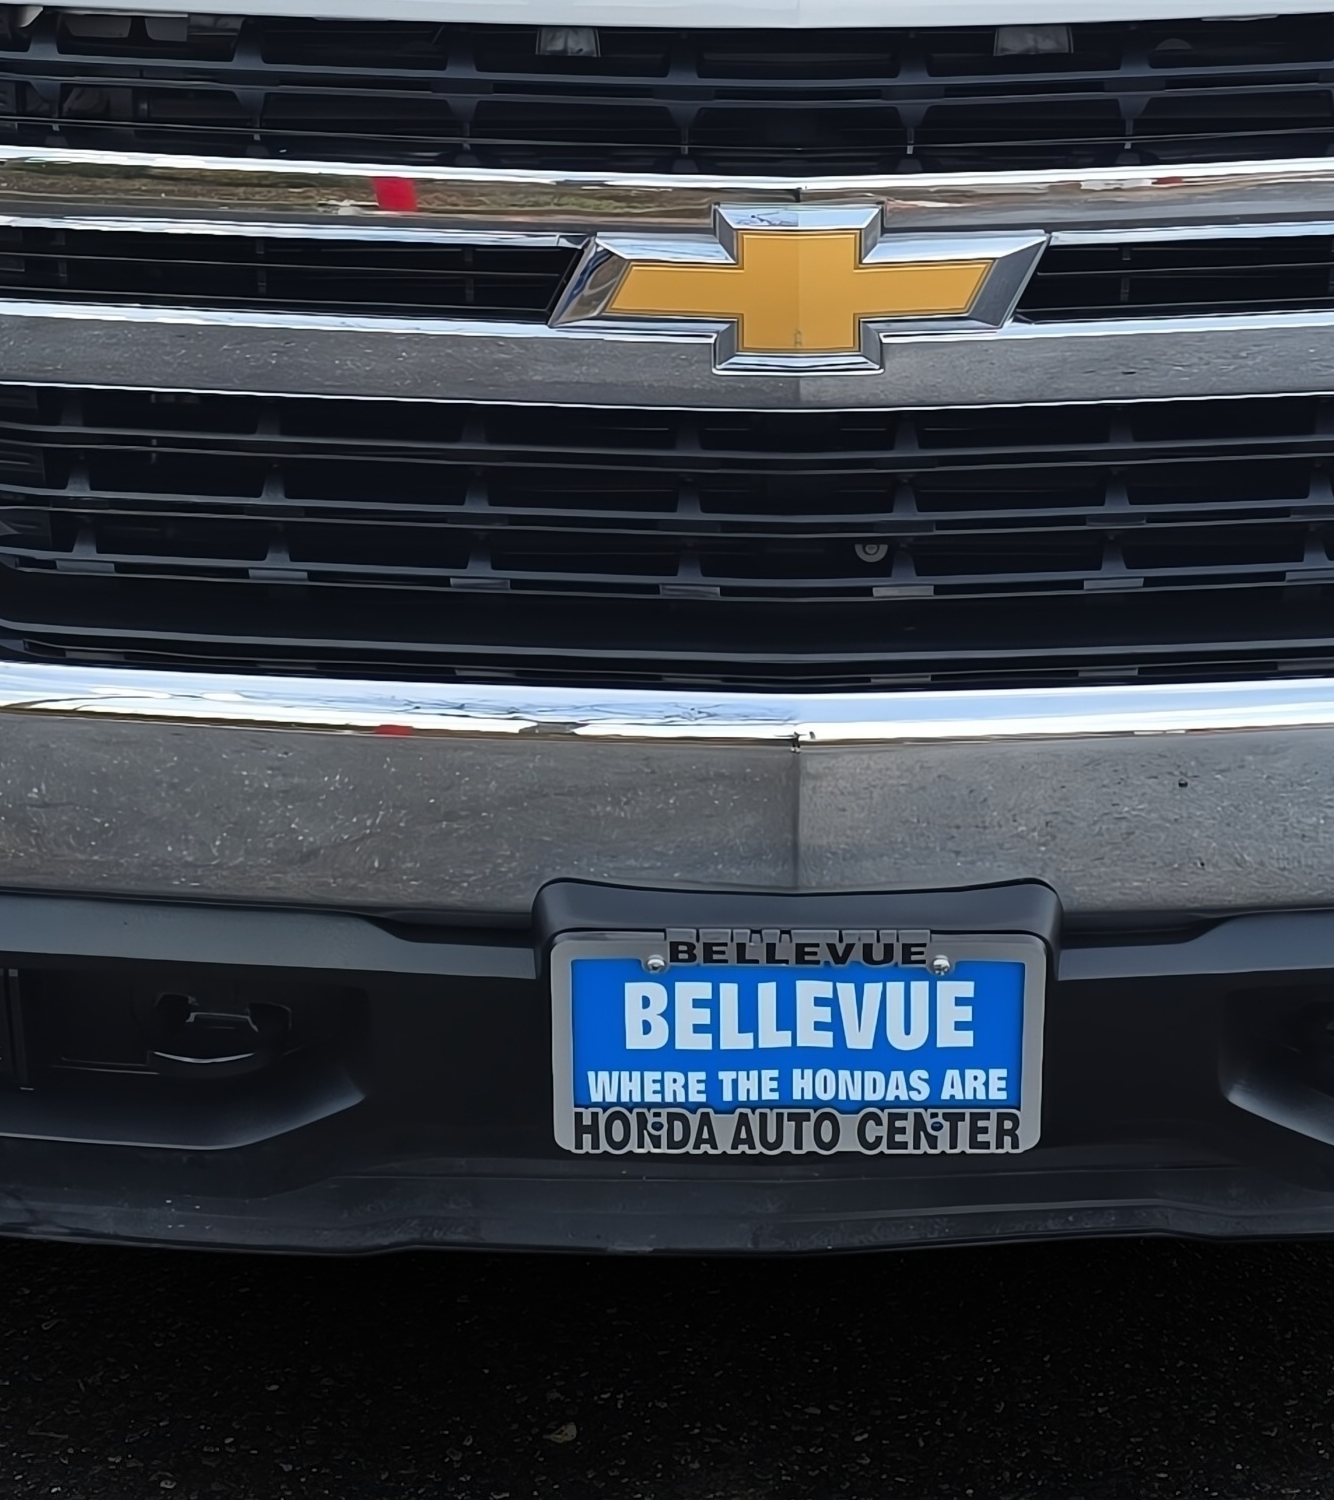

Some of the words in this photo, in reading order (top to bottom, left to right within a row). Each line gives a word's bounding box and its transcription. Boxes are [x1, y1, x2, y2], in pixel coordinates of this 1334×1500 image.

[668, 941, 928, 966] BELLEVUE
[624, 980, 975, 1050] BELLEVUE
[587, 1070, 707, 1103] WHERE
[718, 1070, 779, 1101] THE
[791, 1068, 930, 1102] HONDAS
[941, 1068, 1008, 1101] ARE
[574, 1111, 719, 1151] HONDA
[731, 1111, 841, 1151] AUTO
[857, 1111, 1021, 1151] CENTER
